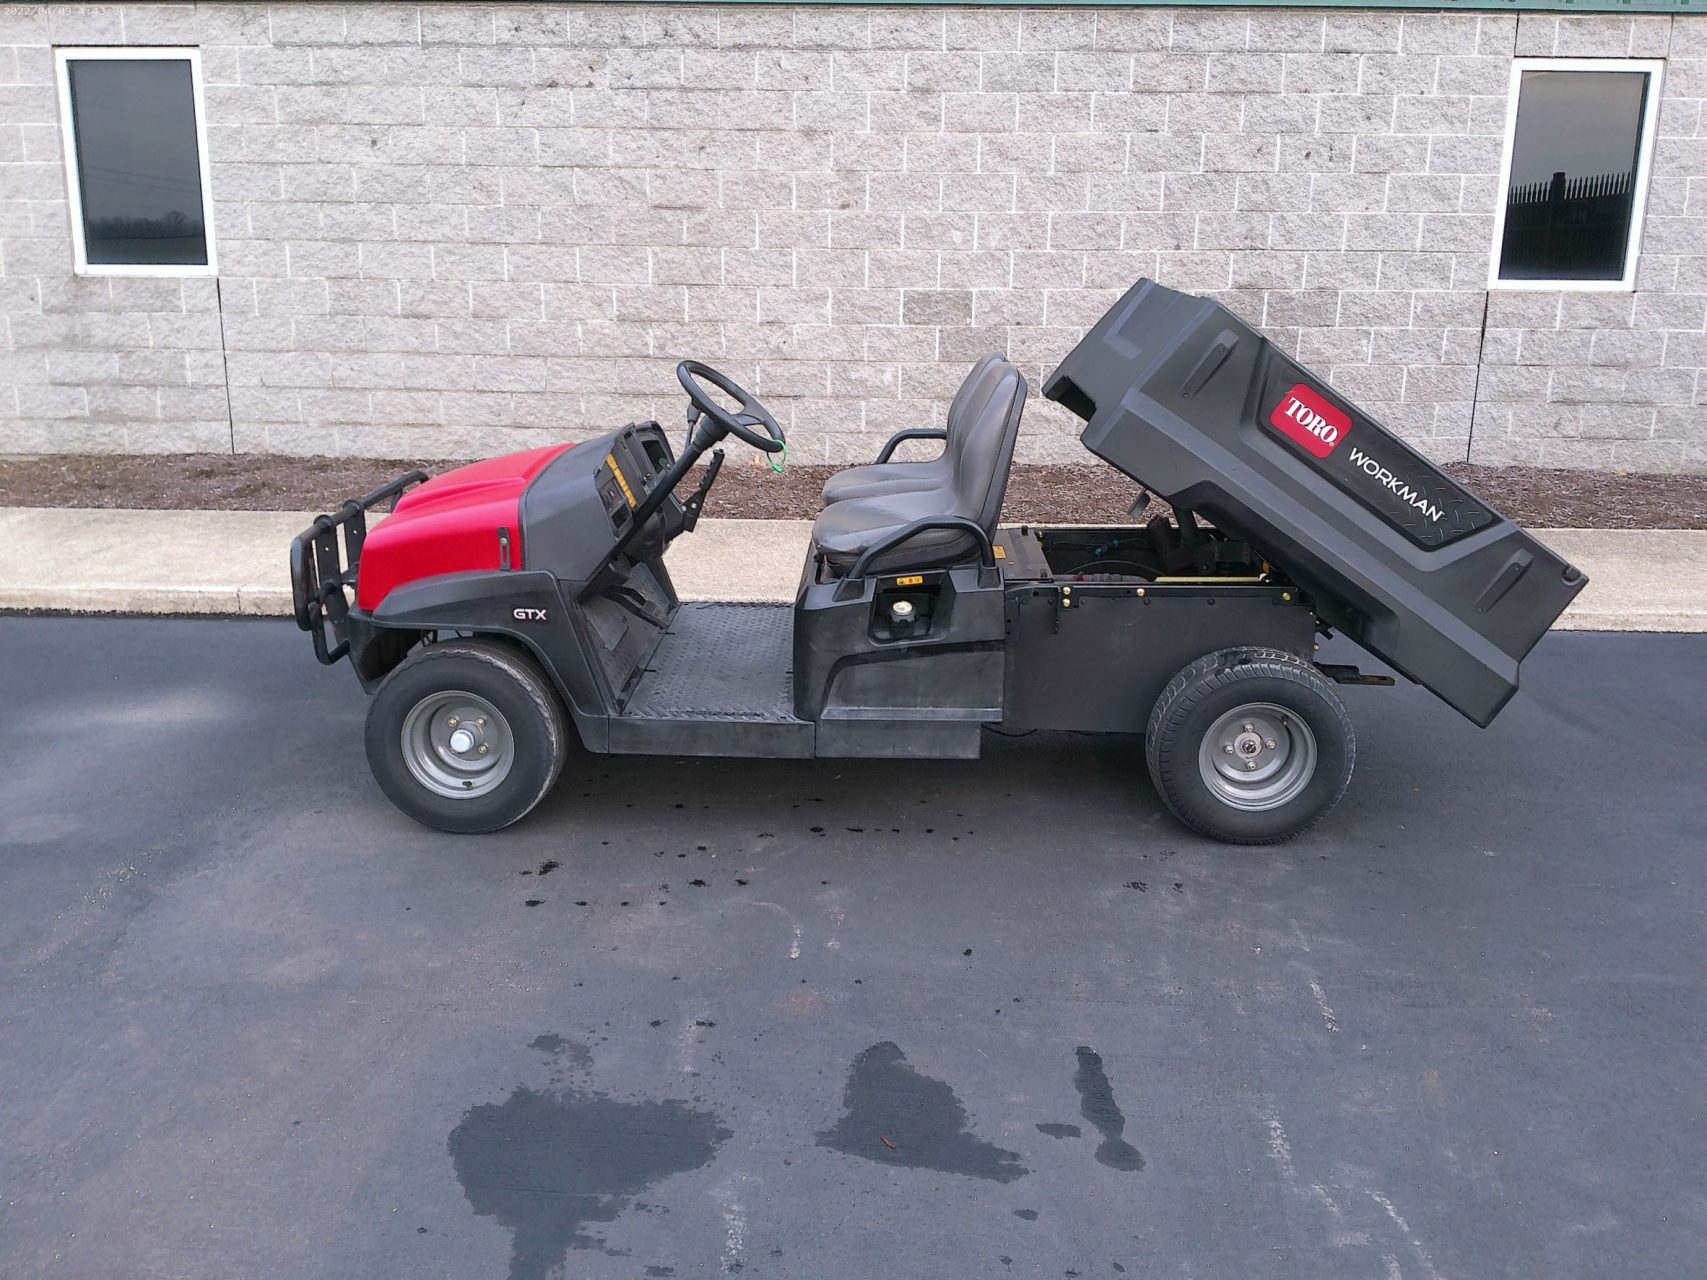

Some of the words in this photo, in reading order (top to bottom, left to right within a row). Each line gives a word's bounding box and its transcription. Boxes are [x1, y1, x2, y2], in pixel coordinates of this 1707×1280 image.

[1284, 397, 1339, 445] TORO
[1348, 446, 1443, 522] WORKMAN
[513, 608, 547, 620] GTX
